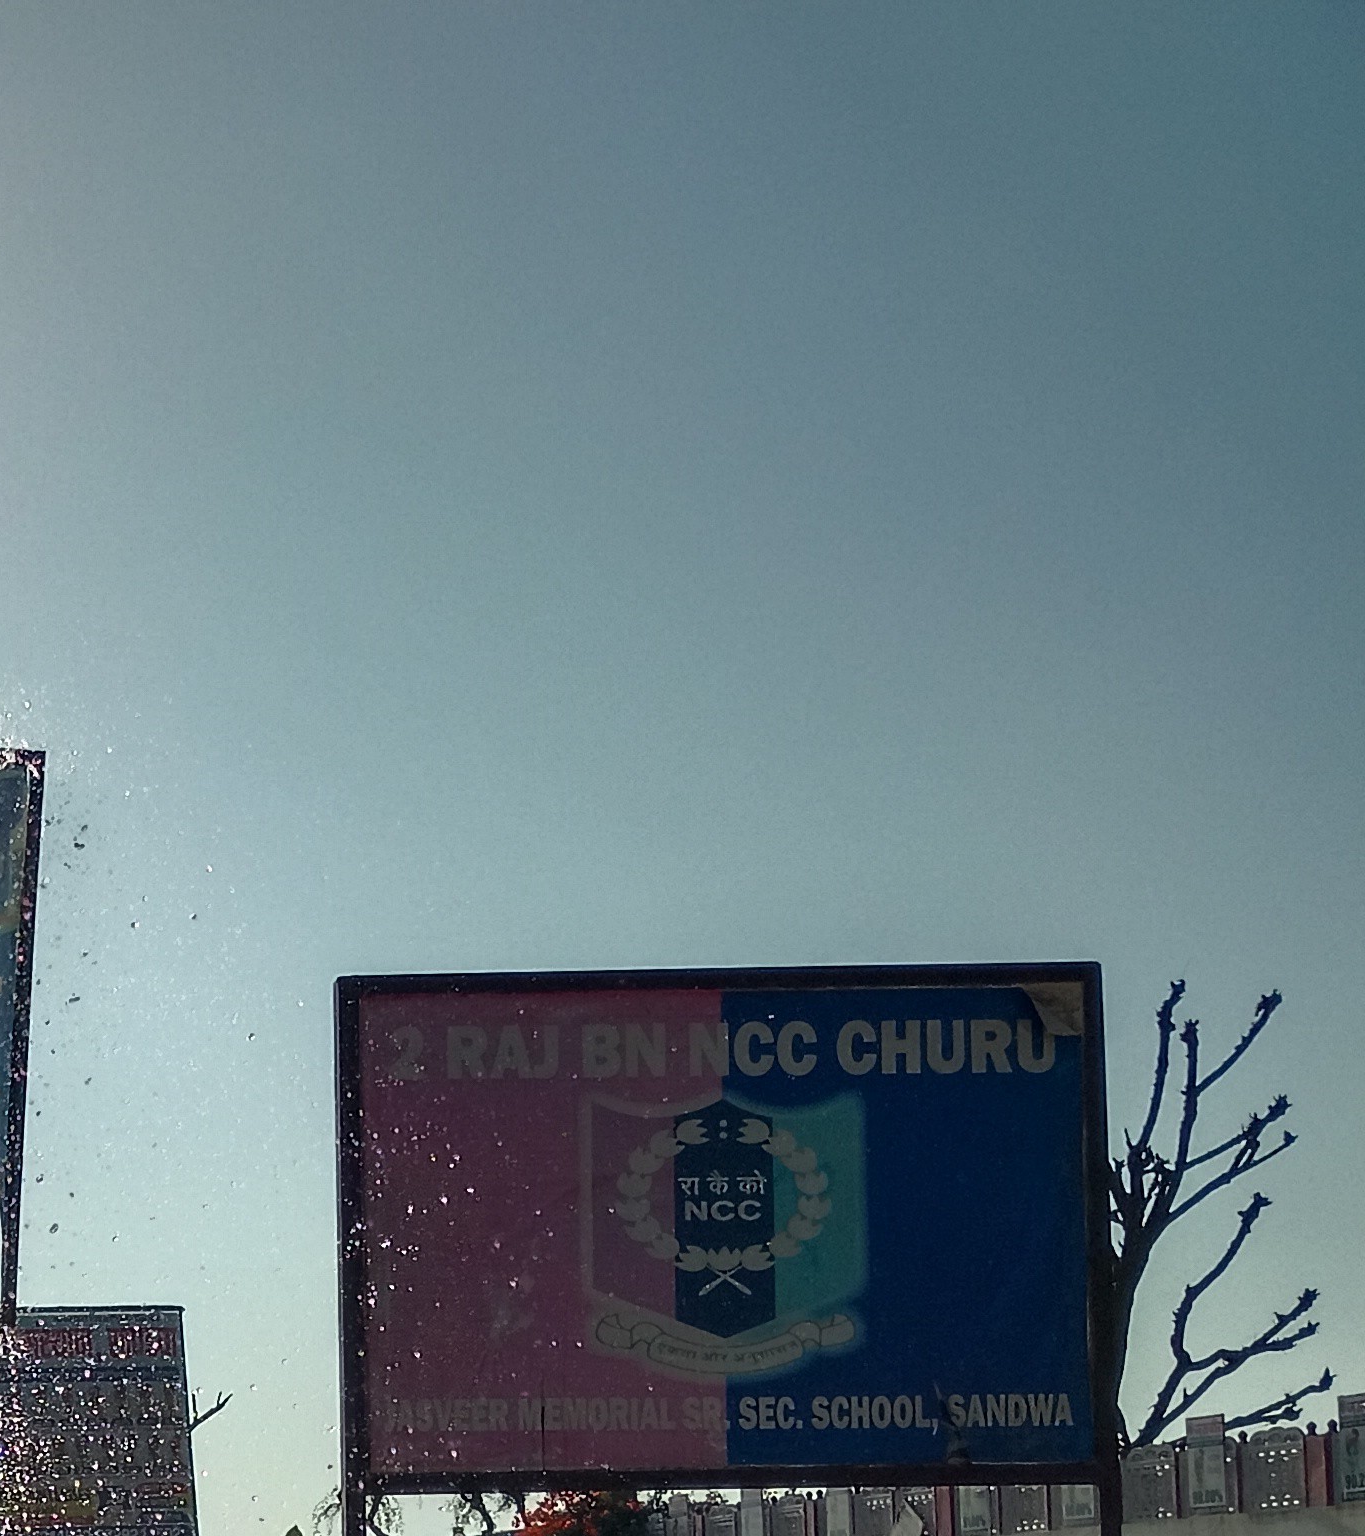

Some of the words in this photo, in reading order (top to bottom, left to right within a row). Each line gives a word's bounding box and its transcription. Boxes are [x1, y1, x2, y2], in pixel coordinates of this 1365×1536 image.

[386, 1025, 427, 1080] 2
[446, 1023, 560, 1080] RAJ
[581, 1021, 667, 1079] BN
[689, 1019, 817, 1077] NCC
[837, 1017, 1056, 1076] CHURU
[736, 1170, 768, 1196] को
[684, 1200, 762, 1222] NCC
[517, 1395, 677, 1432] MEMORIAL
[682, 1395, 732, 1431] SR.
[739, 1395, 803, 1431] SEC.
[811, 1394, 939, 1436] SCHOOL,
[948, 1392, 1075, 1428] SANDWA
